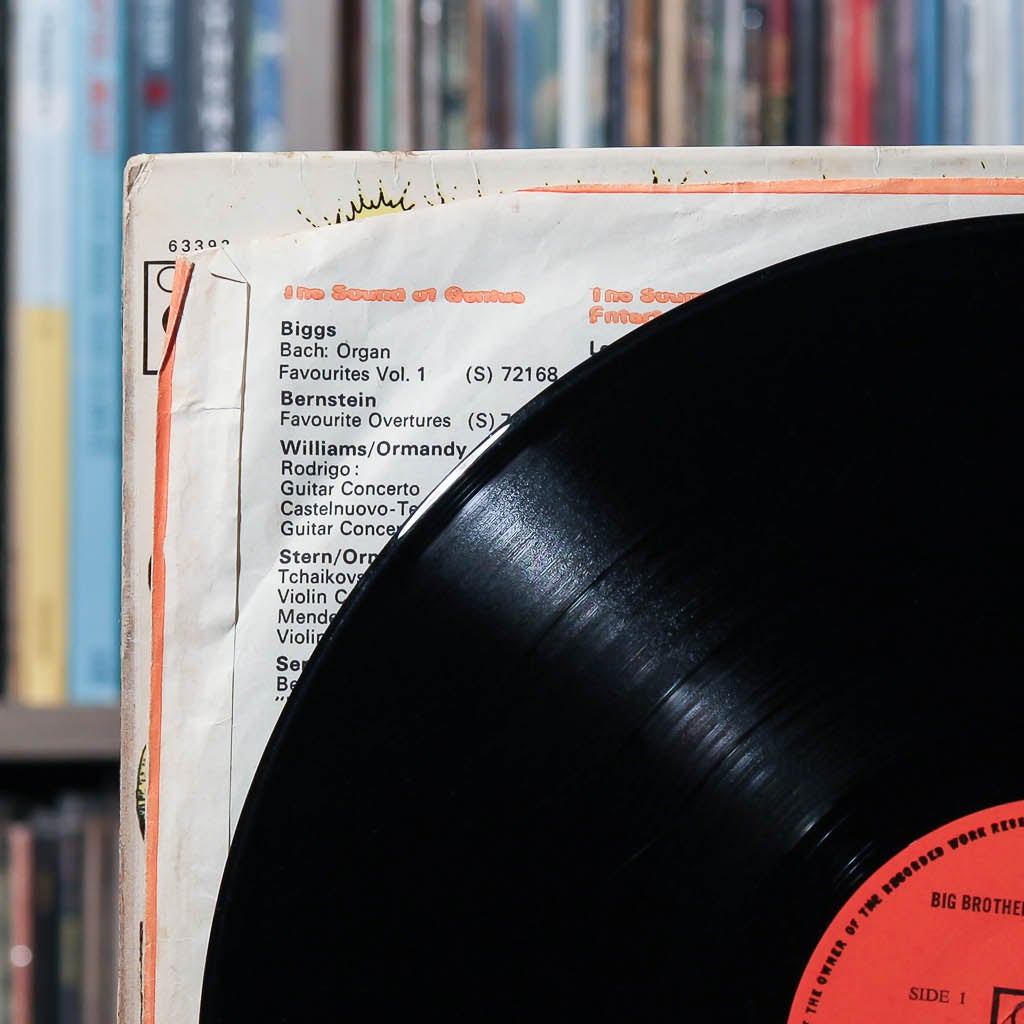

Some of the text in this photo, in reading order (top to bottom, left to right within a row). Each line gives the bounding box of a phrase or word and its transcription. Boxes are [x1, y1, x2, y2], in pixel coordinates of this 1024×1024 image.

[281, 321, 337, 340] Biggs
[280, 343, 390, 362] Bach: Organ
[279, 365, 558, 383] Favourites Vol. (S) 72168
[280, 390, 377, 408] Bernstein
[280, 411, 361, 428] Favourite
[368, 412, 451, 428] Overtures
[468, 412, 495, 431] (S)
[280, 440, 467, 459] Williams/Ormandy
[281, 481, 420, 497] Guitar Concerto
[281, 521, 333, 537] Guitar
[277, 589, 327, 604] Violin
[931, 892, 957, 910] BIG
[805, 989, 823, 1014] THE
[816, 939, 848, 985] OWNER
[881, 846, 945, 895] RECORDED
[947, 827, 988, 850] WORK
[909, 986, 950, 1004] SIDE
